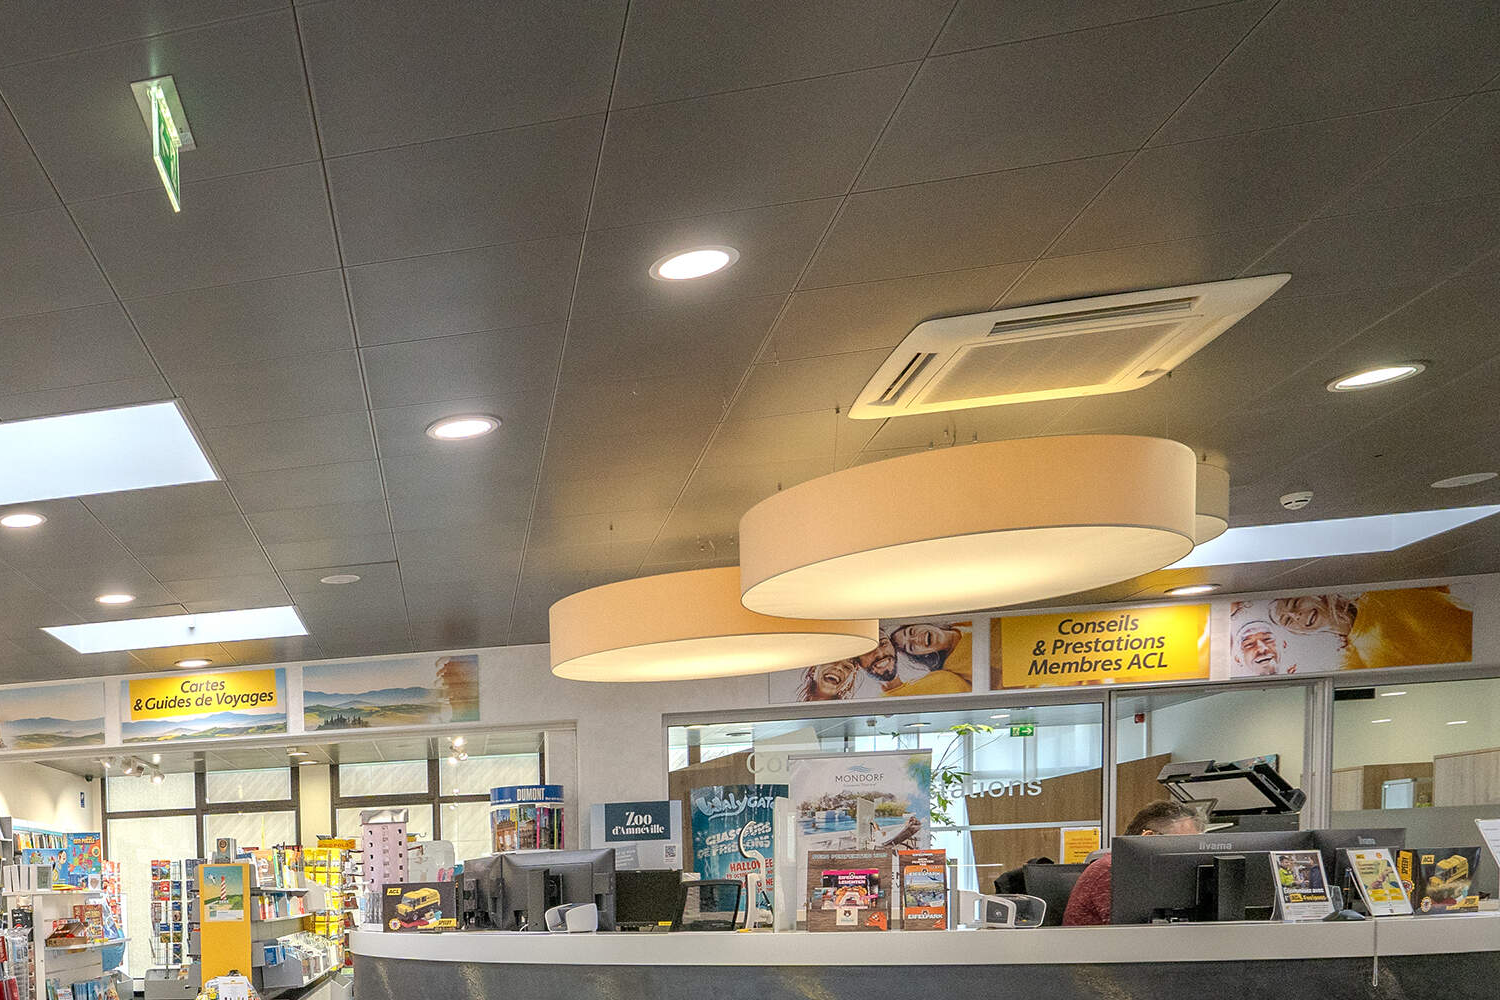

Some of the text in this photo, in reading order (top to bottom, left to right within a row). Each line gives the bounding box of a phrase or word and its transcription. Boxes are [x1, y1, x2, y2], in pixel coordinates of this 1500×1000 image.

[1058, 614, 1140, 636] Conseils
[1032, 634, 1166, 656] & Prestations
[1027, 652, 1169, 676] Membres ACL
[180, 680, 226, 694] Cartes
[133, 690, 274, 711] & Guides de Voyages
[835, 772, 885, 784] MONDORF
[516, 787, 546, 801] DUMONT
[625, 811, 653, 826] Zoo
[611, 824, 665, 836] d'Amnéville
[729, 858, 774, 873] HALLOEE
[1401, 857, 1409, 875] SPEEDY
